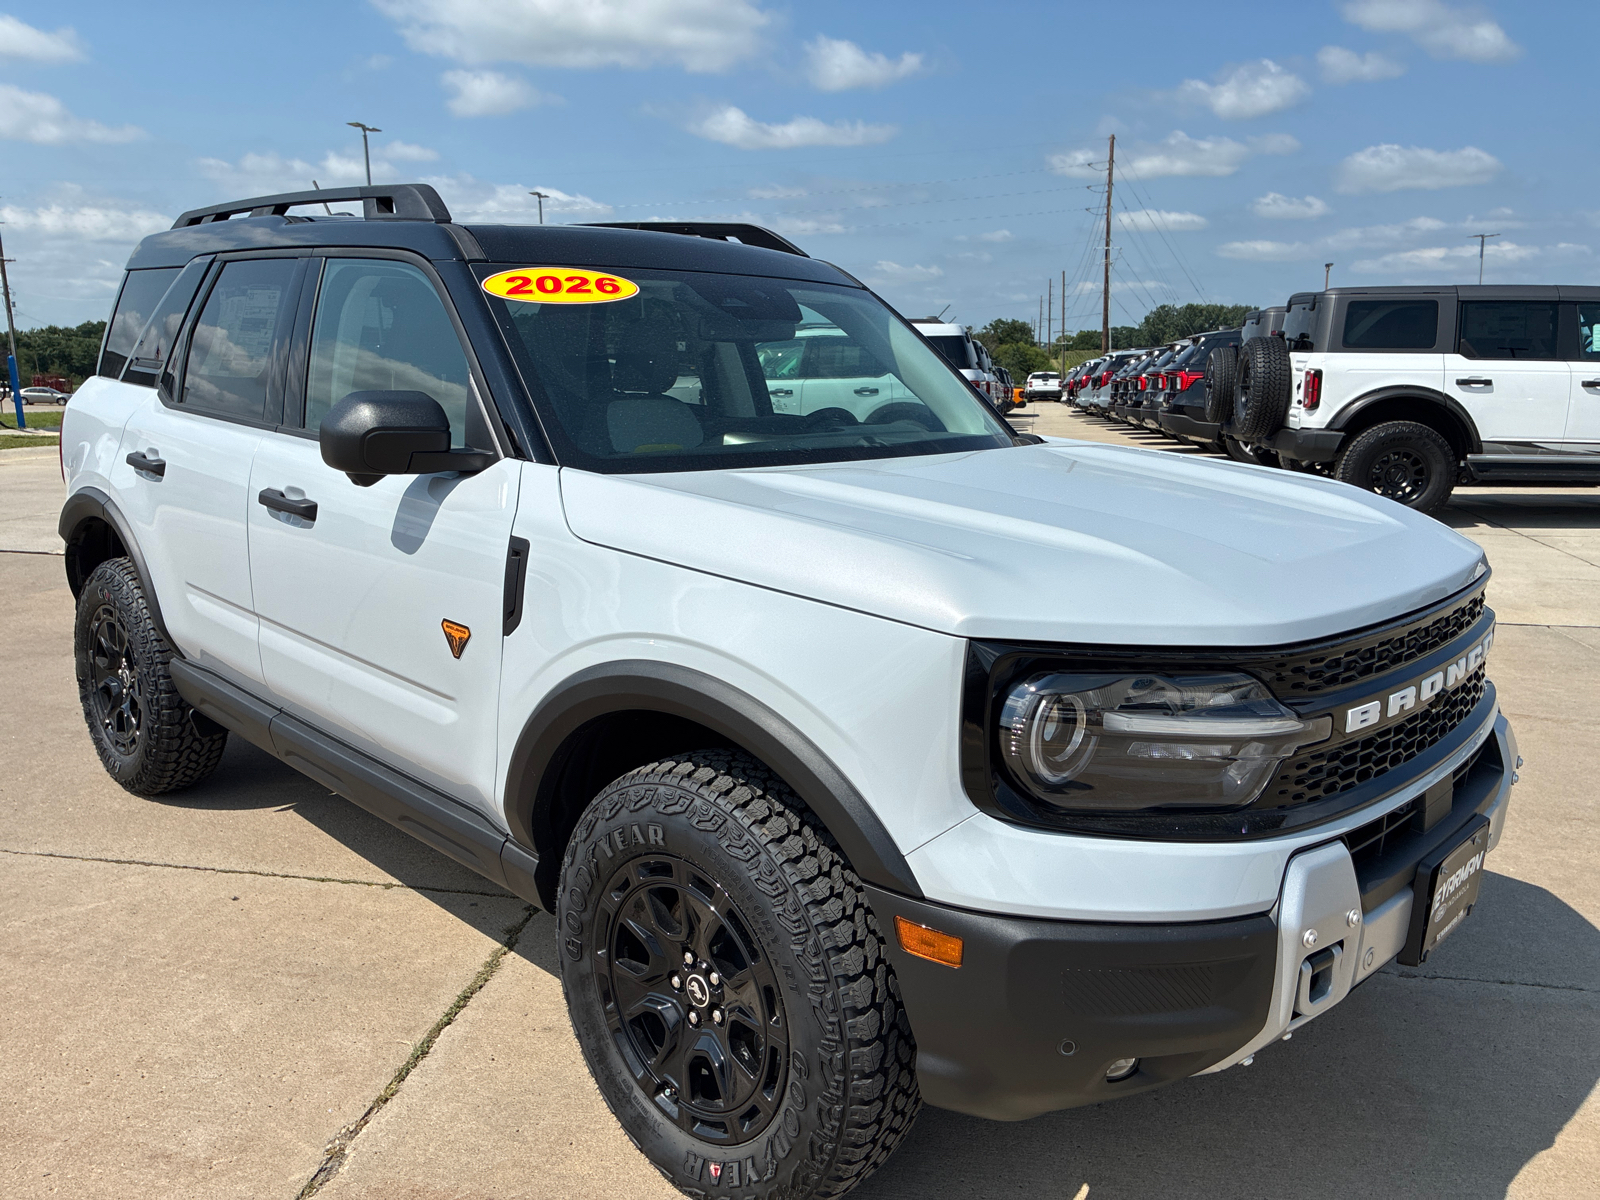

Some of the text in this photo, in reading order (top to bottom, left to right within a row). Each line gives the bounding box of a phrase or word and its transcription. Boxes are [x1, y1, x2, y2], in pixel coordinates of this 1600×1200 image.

[505, 275, 622, 295] 2026
[565, 822, 666, 961] GOODYEAR
[684, 1050, 809, 1188] GOODYEAR
